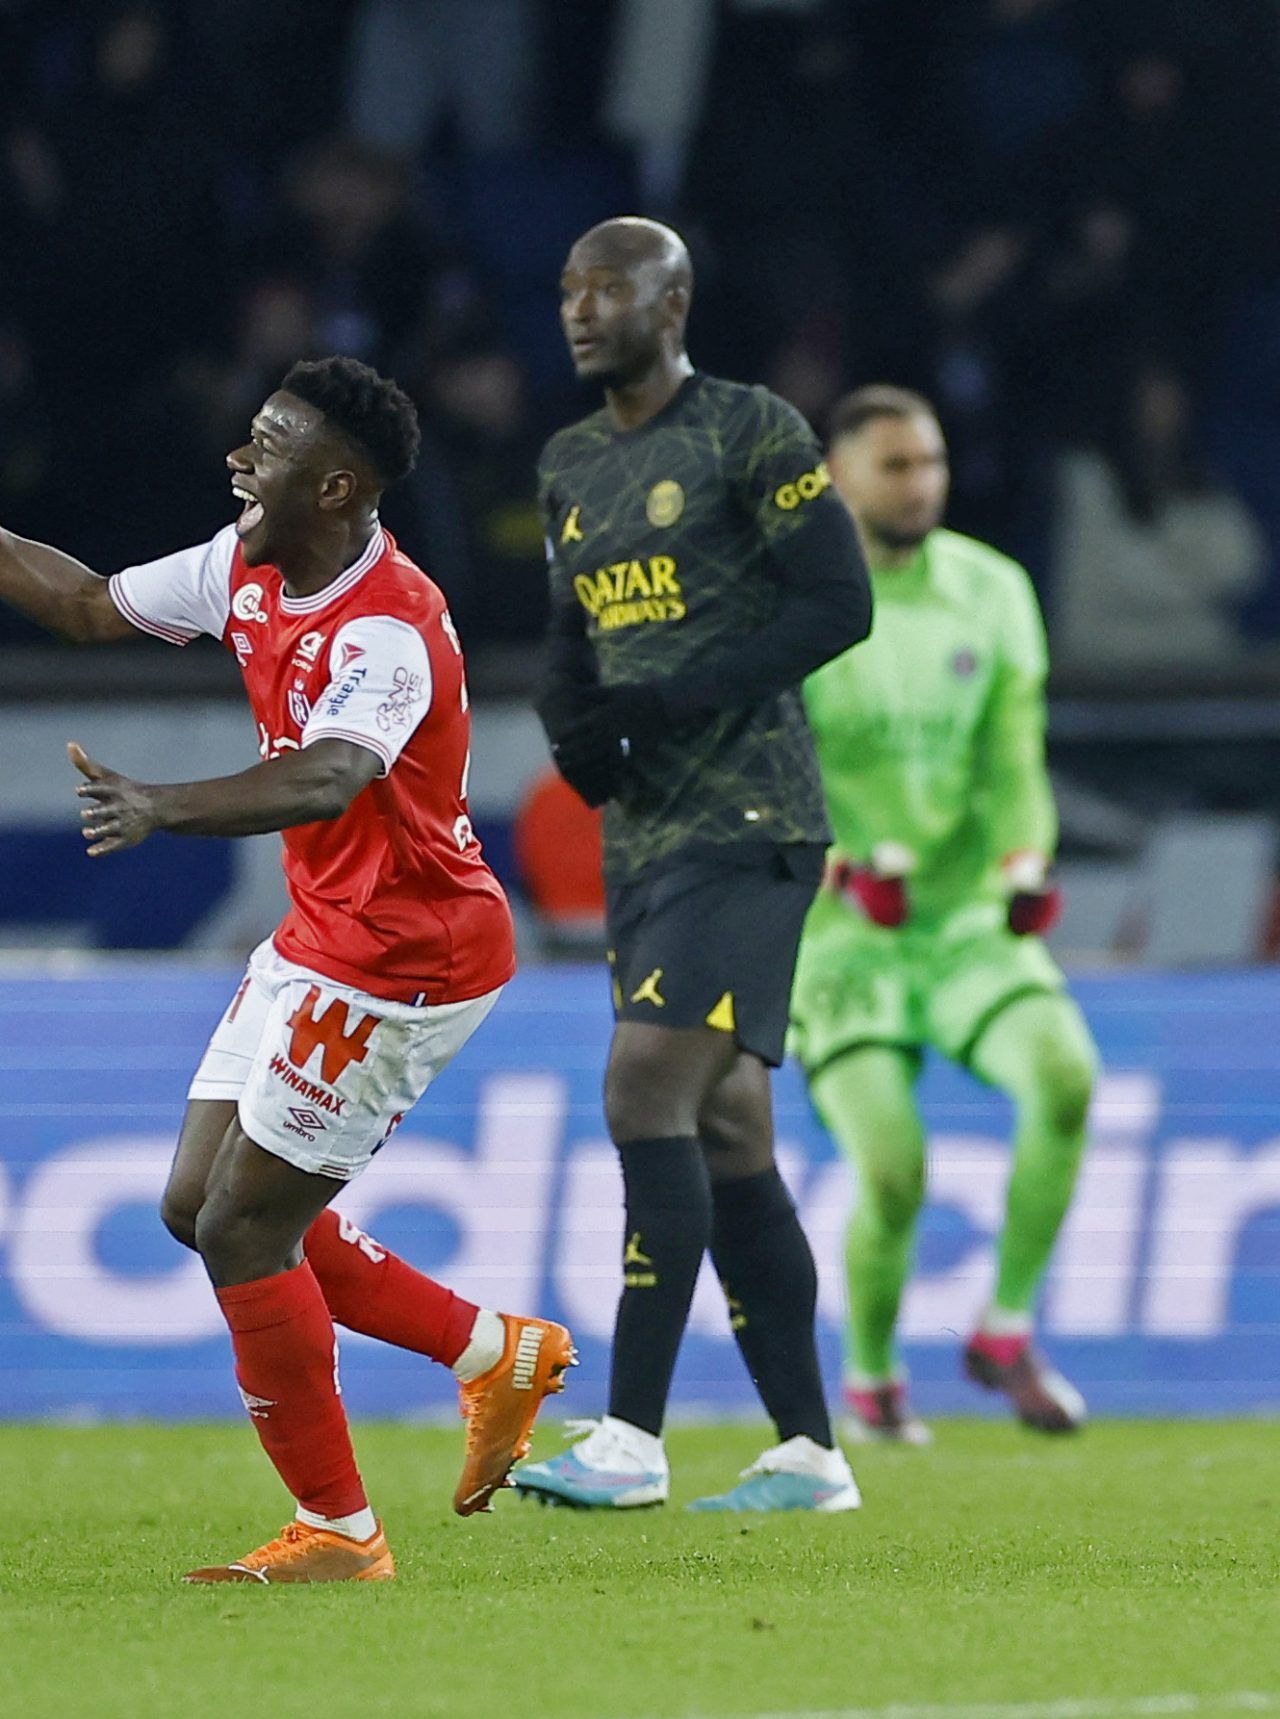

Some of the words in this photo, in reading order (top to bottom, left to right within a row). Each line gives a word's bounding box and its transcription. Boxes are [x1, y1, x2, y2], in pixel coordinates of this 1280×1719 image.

[774, 461, 830, 510] GOA
[573, 555, 681, 617] QATAR
[268, 1052, 346, 1116] WINAMAX
[283, 1120, 316, 1142] umbro
[512, 1326, 545, 1390] PUMA
